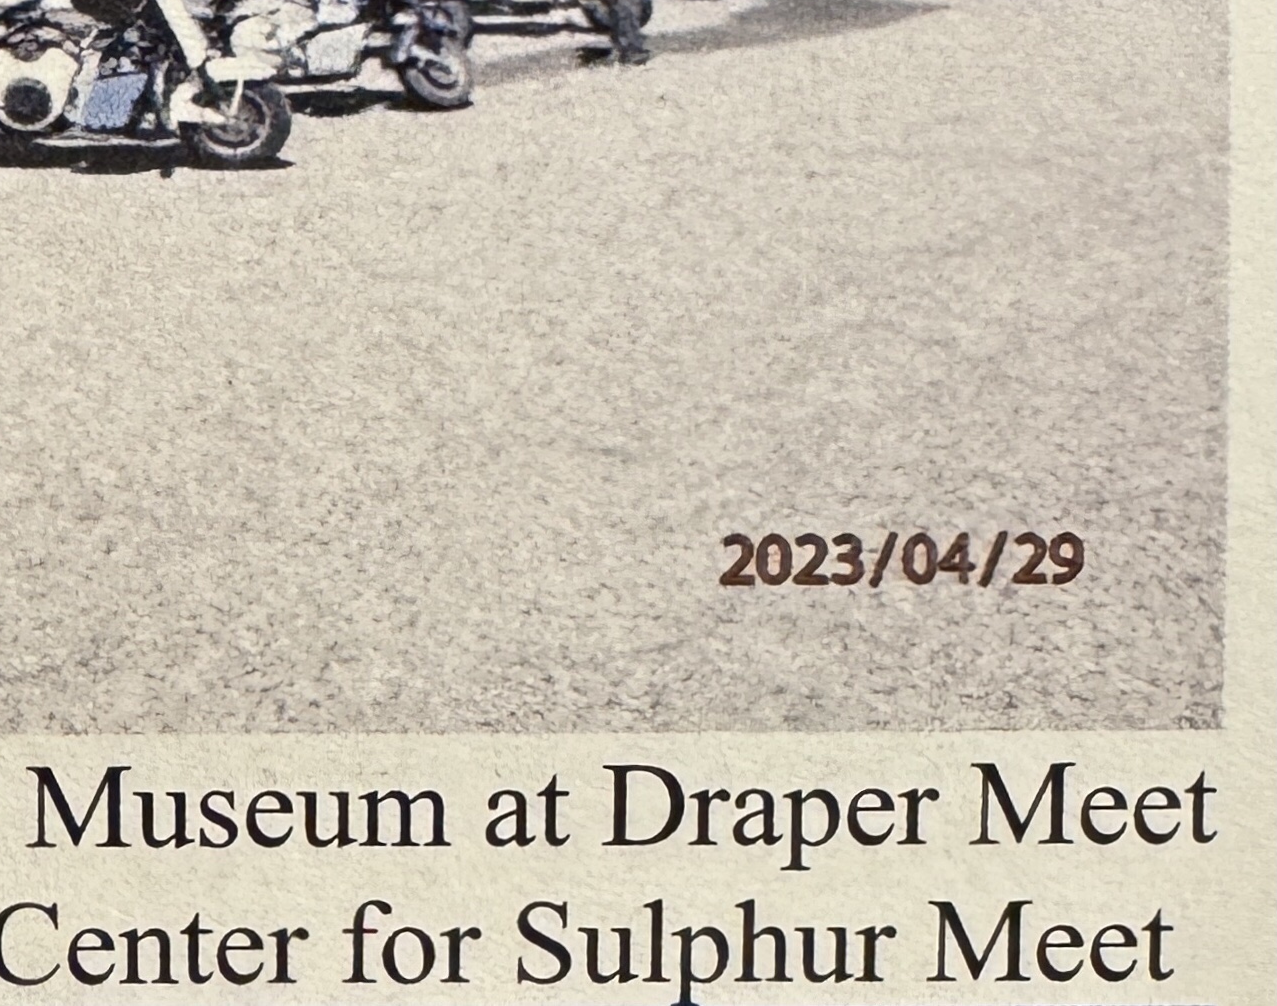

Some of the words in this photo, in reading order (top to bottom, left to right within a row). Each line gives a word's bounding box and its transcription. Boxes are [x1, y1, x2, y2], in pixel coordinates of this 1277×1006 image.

[26, 766, 451, 848] Museum
[486, 775, 570, 846] at
[602, 765, 939, 870] Draper
[970, 763, 1217, 844] Meet
[343, 900, 481, 984] for
[518, 899, 896, 1006] Sulphur
[927, 901, 1174, 981] Meet
